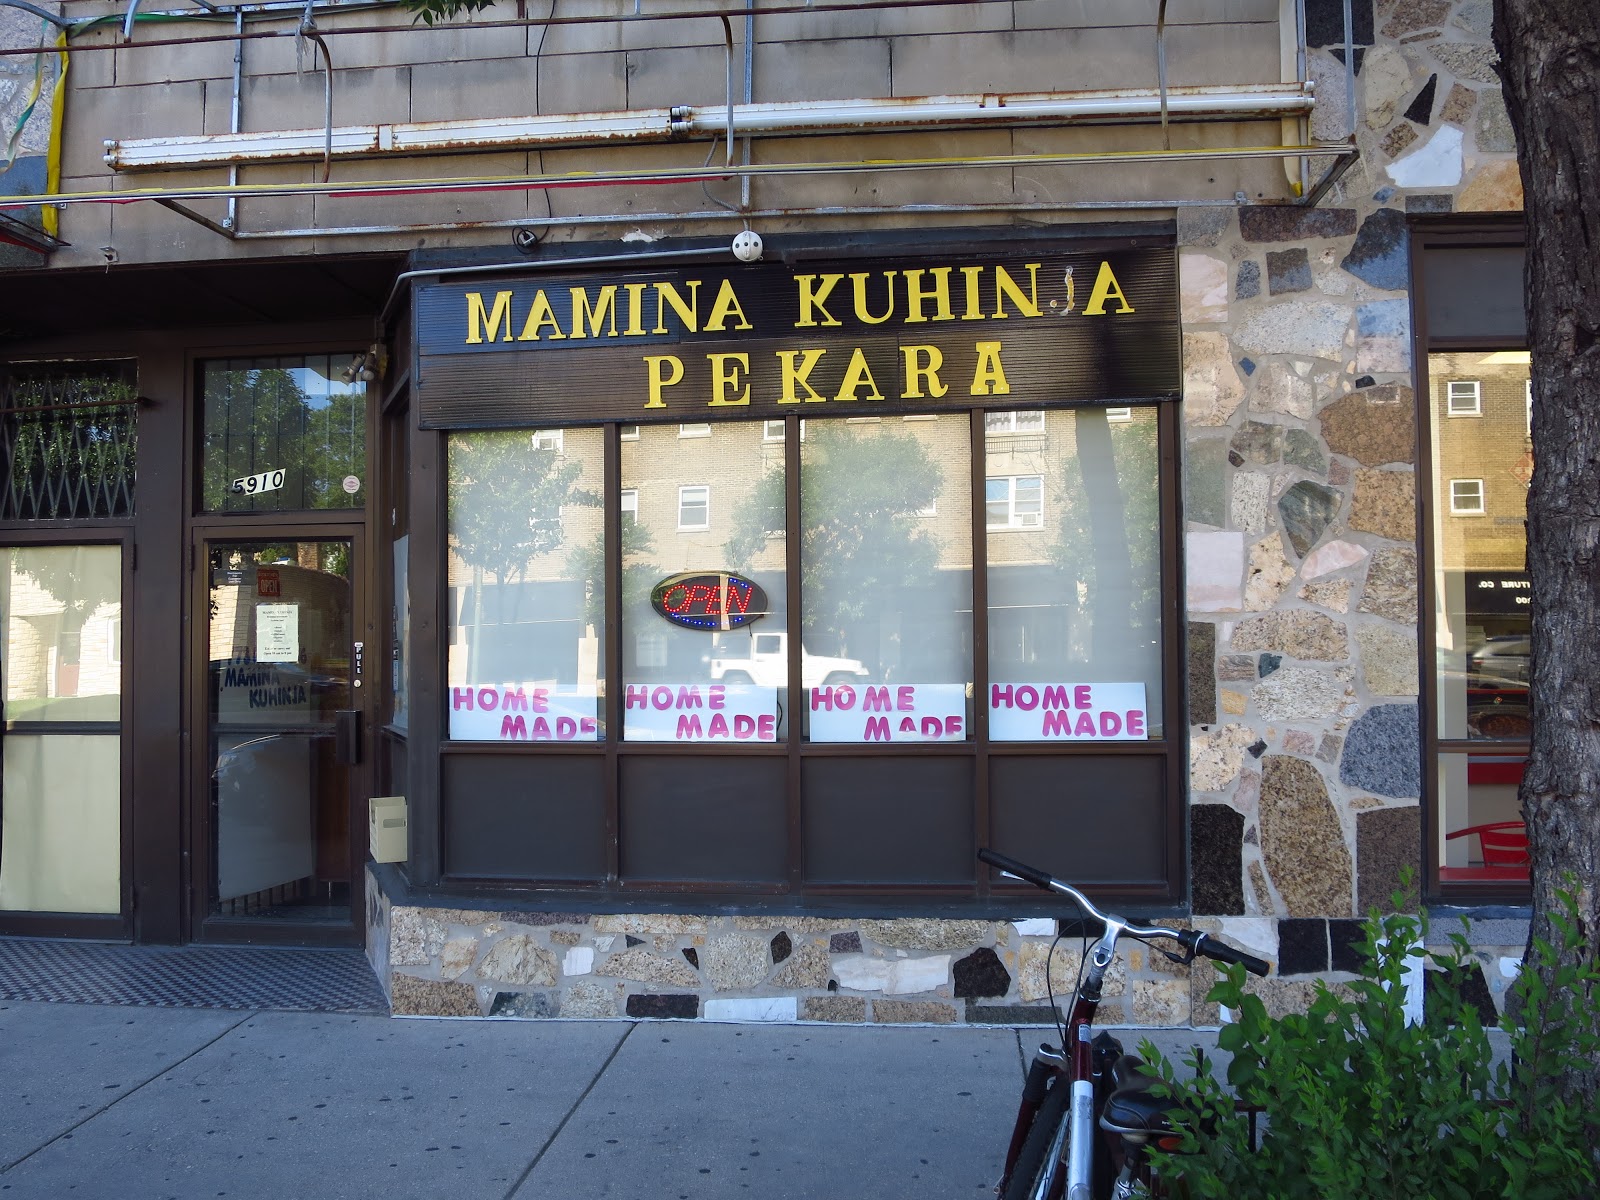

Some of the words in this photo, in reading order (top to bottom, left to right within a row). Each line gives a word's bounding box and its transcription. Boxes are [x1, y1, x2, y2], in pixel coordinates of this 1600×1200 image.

[465, 279, 753, 344] MAMINA
[794, 261, 1135, 327] KUHINJA
[643, 341, 1010, 409] PEKARA
[231, 470, 284, 494] 5910
[663, 584, 753, 615] OPEN
[249, 686, 307, 709] KUHINJA
[453, 686, 549, 713] HOME
[625, 685, 726, 711] HOME
[811, 685, 915, 712] HOME
[991, 684, 1093, 711] HOME
[500, 714, 597, 741] MADE
[676, 713, 776, 740] MADE
[1042, 710, 1146, 737] MADE
